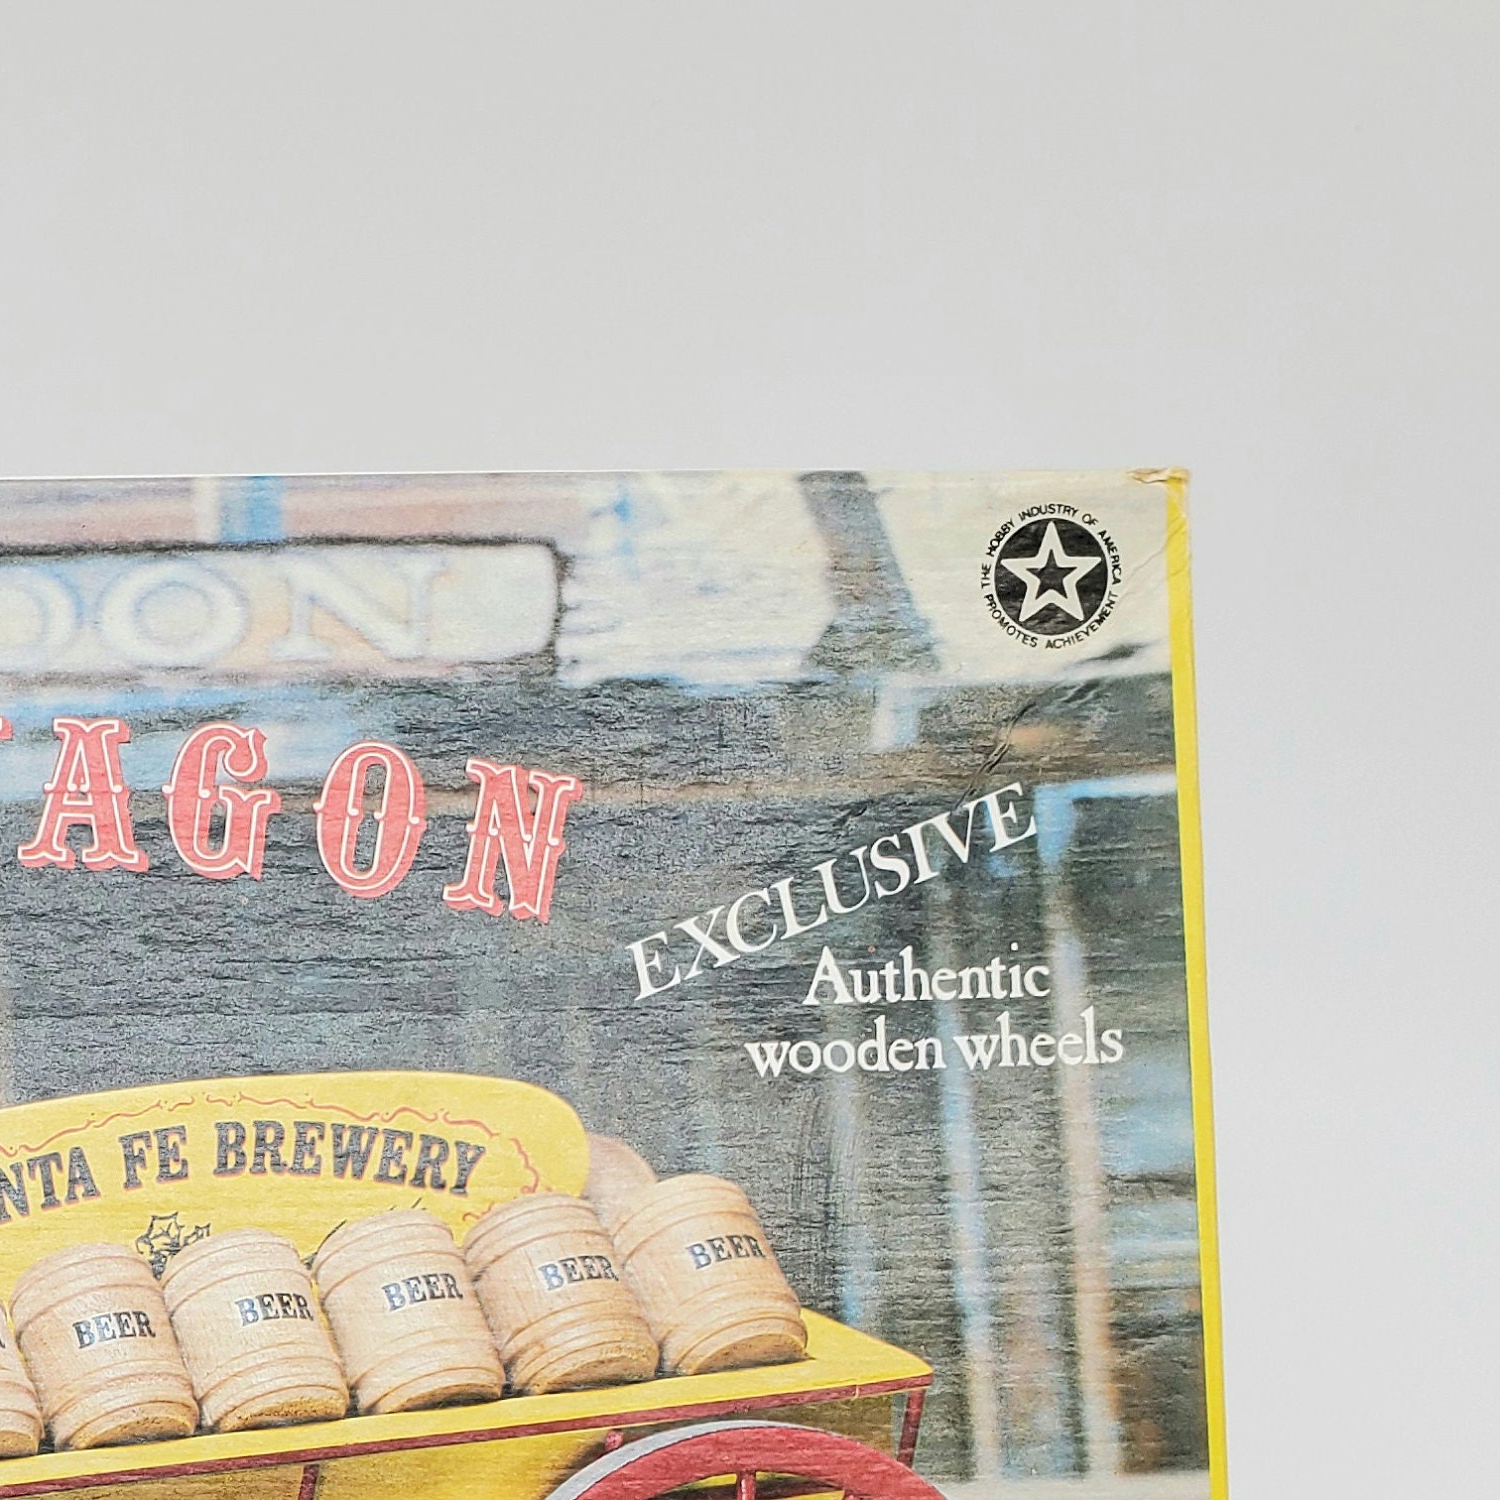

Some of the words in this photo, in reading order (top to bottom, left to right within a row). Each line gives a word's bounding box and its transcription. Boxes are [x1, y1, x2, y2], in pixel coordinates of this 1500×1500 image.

[980, 563, 992, 589] THE
[986, 518, 1016, 558] HOBBY
[1018, 503, 1079, 522] INDUSTRY
[1082, 513, 1099, 527] OF
[1097, 530, 1122, 586] AMERICA
[983, 593, 1038, 648] PROMOTES
[1045, 591, 1119, 649] ACHIEVEMENT
[624, 782, 1039, 1001] EXCLUSIVE
[802, 942, 1051, 1006] Authentic
[744, 1015, 947, 1078] wooden
[953, 1006, 1123, 1072] wheels
[118, 1123, 191, 1191] FE
[212, 1118, 489, 1198] BREWERY
[538, 1254, 619, 1292] BEER
[685, 1233, 767, 1270] BEER
[233, 1292, 315, 1327] BEER
[381, 1272, 464, 1311] BEER
[72, 1310, 157, 1349] BEER
